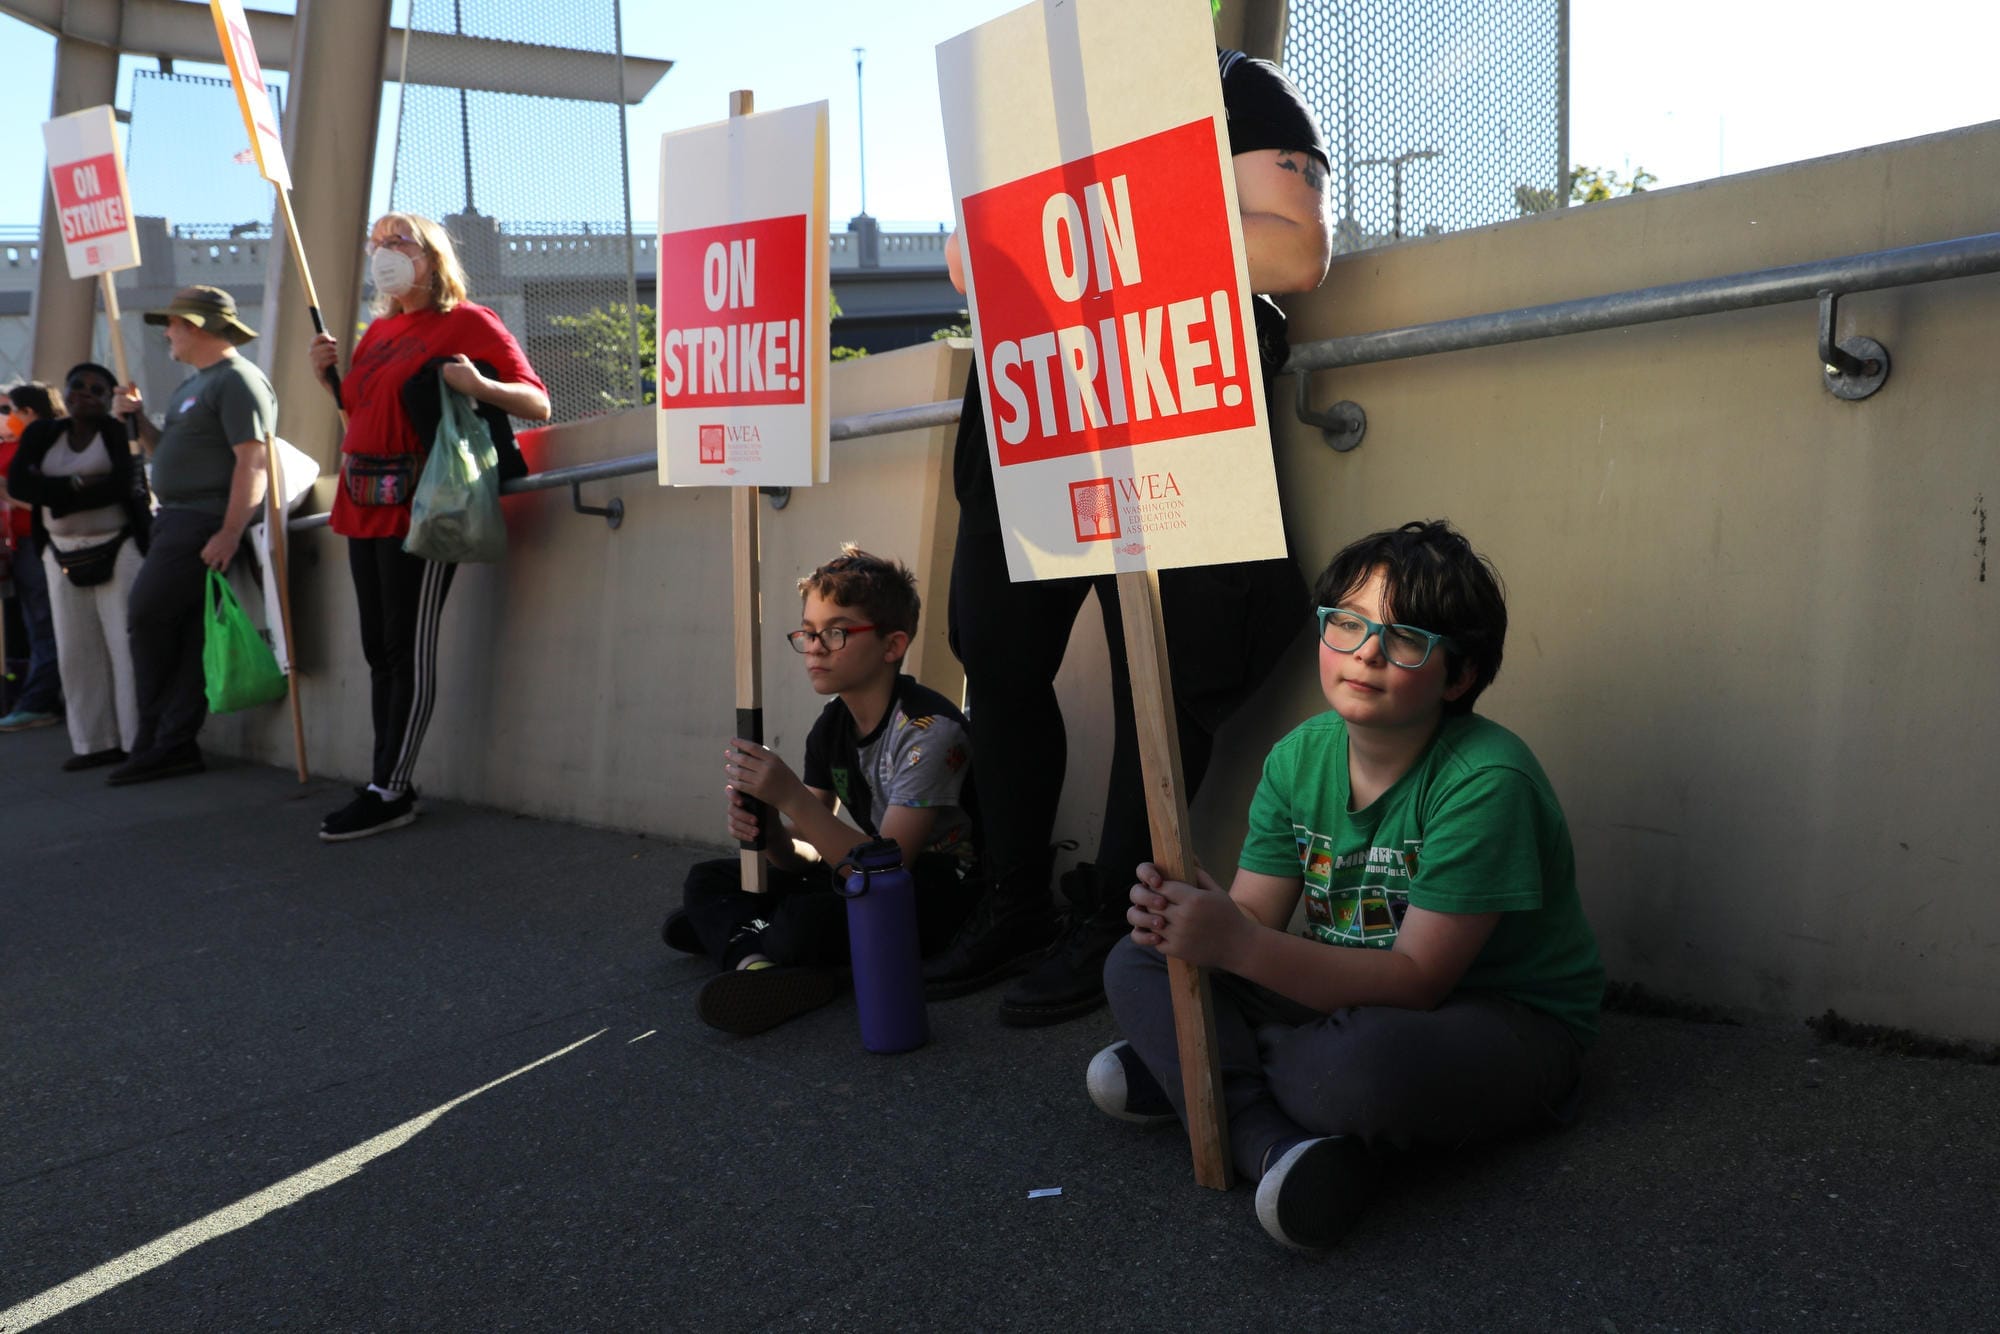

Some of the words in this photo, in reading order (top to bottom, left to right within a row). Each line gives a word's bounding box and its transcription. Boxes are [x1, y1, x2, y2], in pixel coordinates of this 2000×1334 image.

[73, 164, 101, 199] ON
[63, 196, 126, 239] STRIKE!
[1042, 174, 1142, 303] ON
[703, 238, 756, 312] ON
[664, 318, 801, 397] STRIKE!
[992, 290, 1243, 445] STRIKE!
[727, 425, 761, 442] WEA
[1118, 472, 1181, 503] WEA
[1123, 500, 1184, 514] WASHINGTON
[1129, 511, 1181, 525] EDUCATION
[1126, 520, 1187, 535] ASSOCIATION
